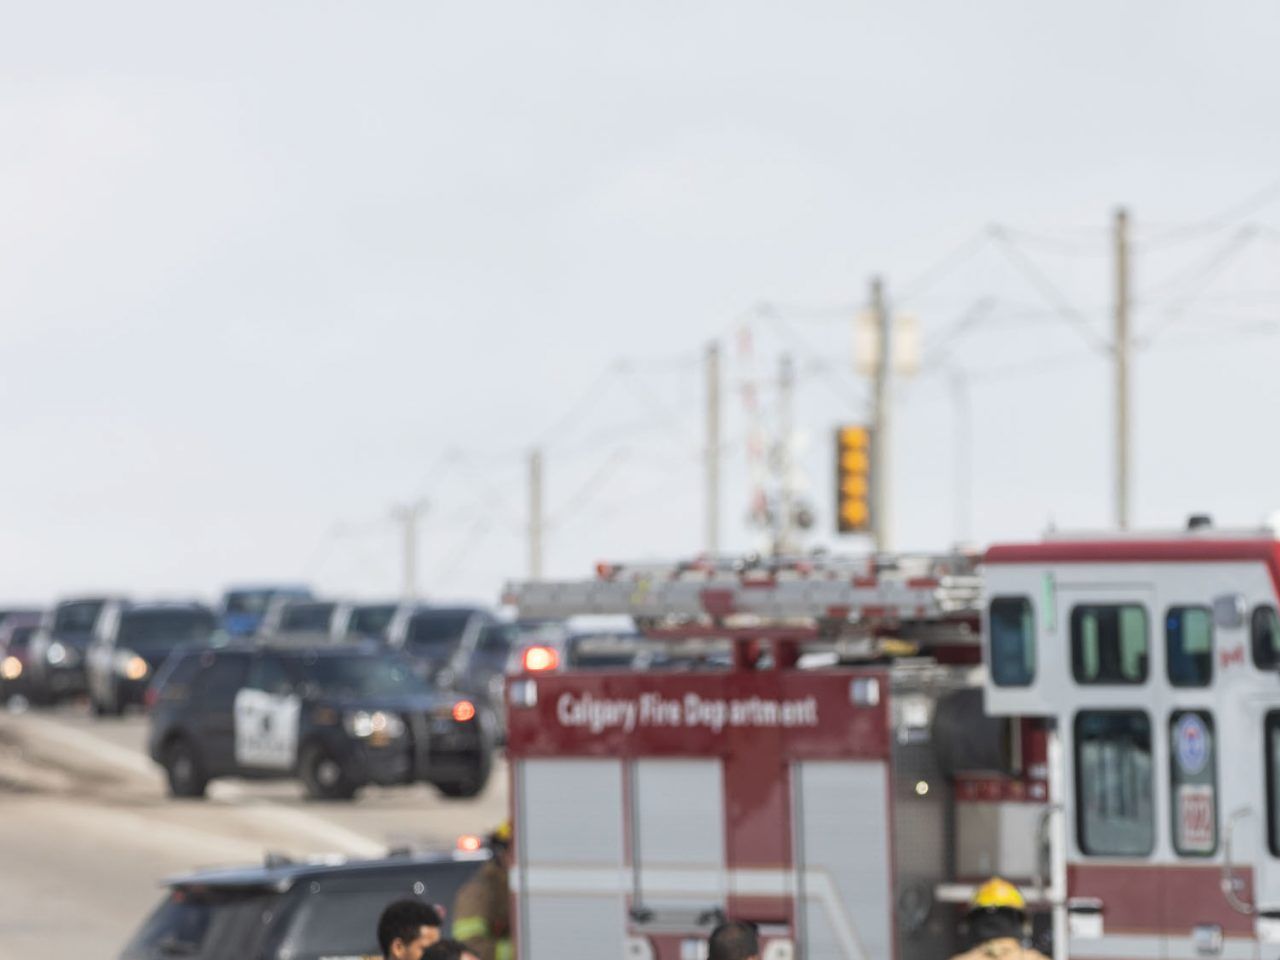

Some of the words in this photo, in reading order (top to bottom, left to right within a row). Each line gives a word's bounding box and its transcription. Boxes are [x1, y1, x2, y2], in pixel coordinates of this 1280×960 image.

[557, 692, 636, 733] Calgary
[639, 692, 681, 726] Fire
[684, 692, 818, 733] Department
